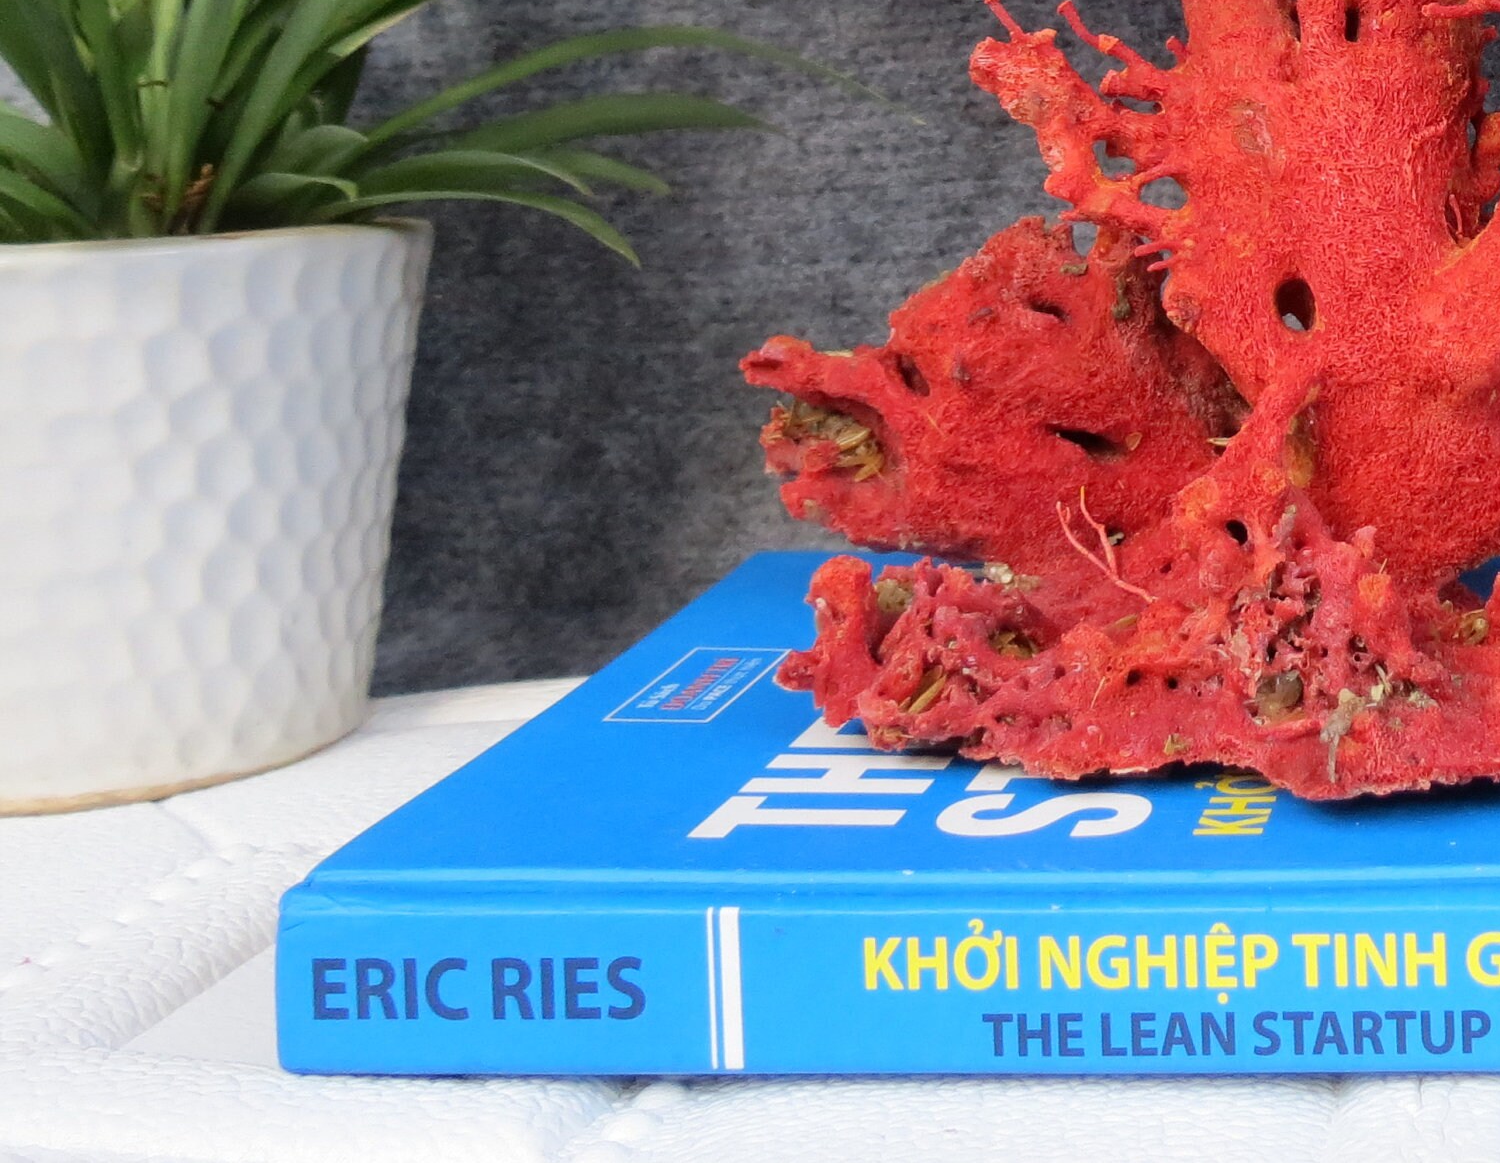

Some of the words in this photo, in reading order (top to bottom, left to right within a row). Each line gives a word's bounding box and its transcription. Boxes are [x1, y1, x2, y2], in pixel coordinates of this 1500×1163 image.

[1192, 774, 1278, 836] KHỞ
[312, 957, 469, 1020] ERIC
[491, 955, 646, 1020] RIES
[863, 918, 1019, 990] KHỞI
[1038, 922, 1280, 1005] NGHIỆP
[1291, 932, 1448, 988] TINH
[982, 1011, 1085, 1057] THE
[1100, 1011, 1237, 1057] LEAN
[1252, 1009, 1492, 1056] STARTUP
